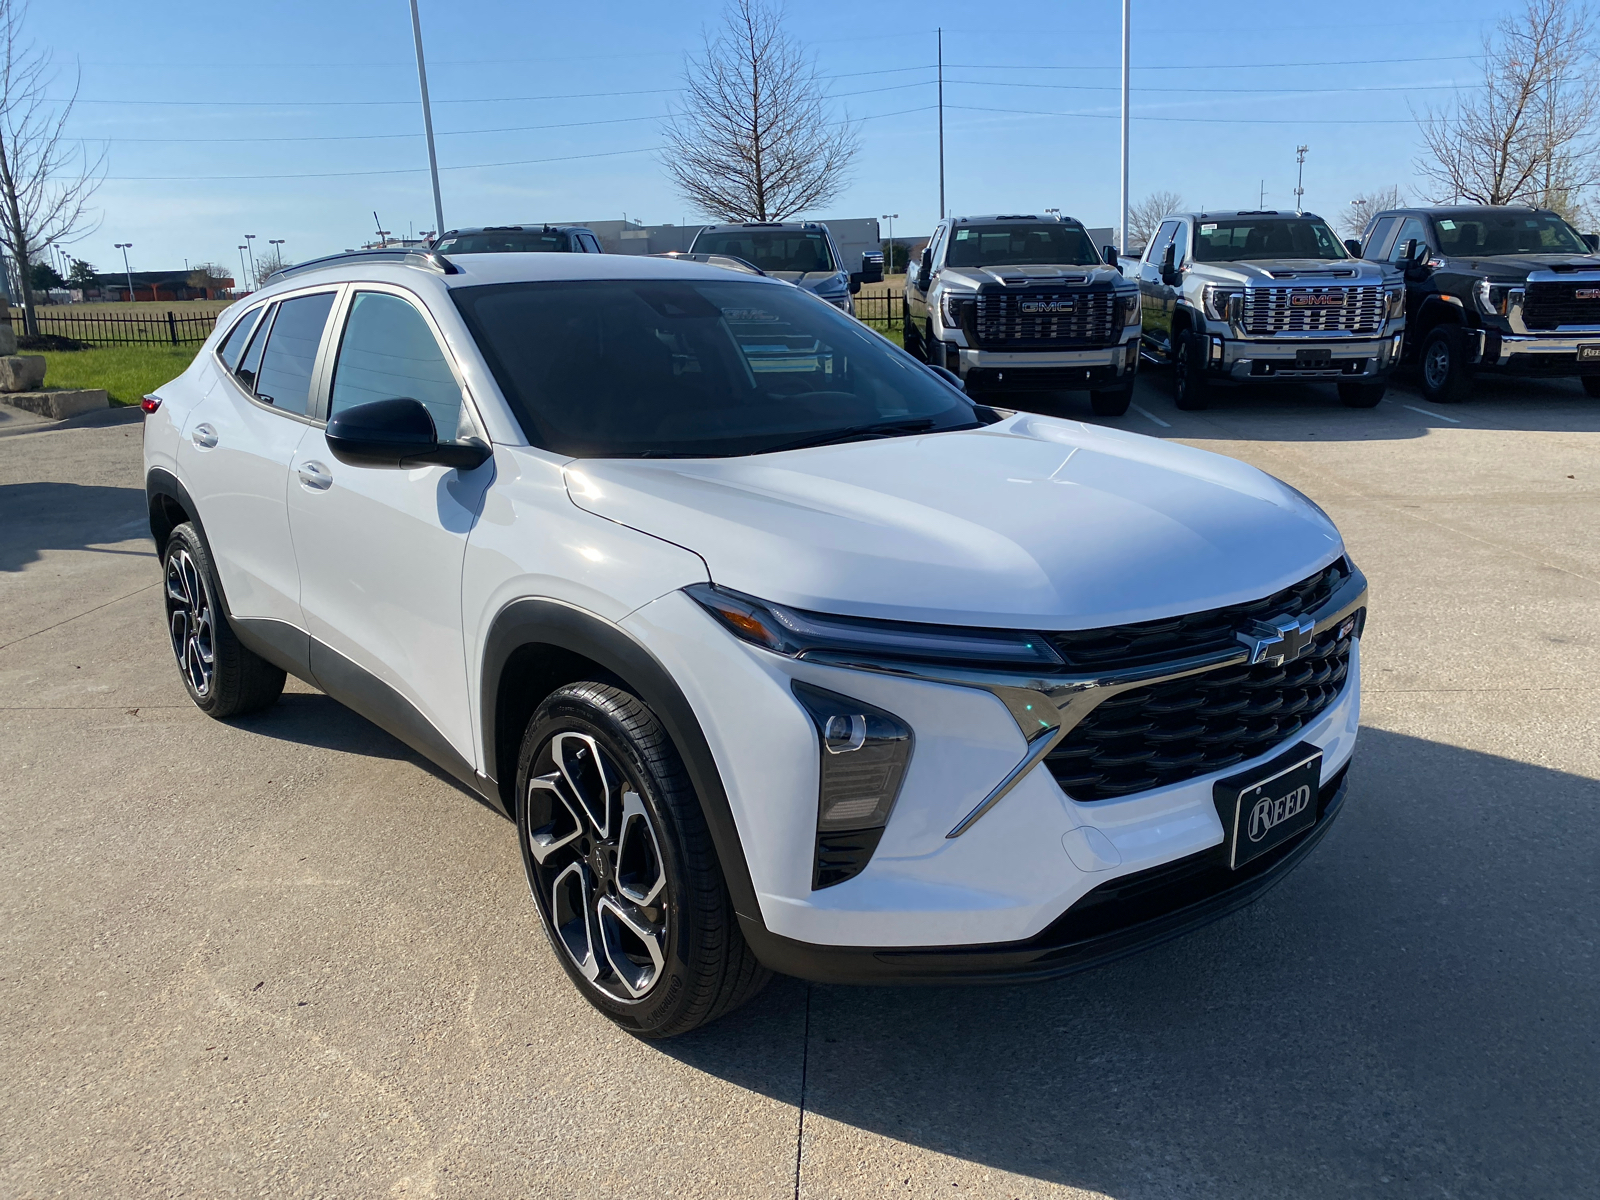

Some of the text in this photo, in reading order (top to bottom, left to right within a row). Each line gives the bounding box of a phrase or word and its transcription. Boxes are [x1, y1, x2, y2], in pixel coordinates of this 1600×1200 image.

[1292, 295, 1343, 305] GMC
[1022, 301, 1074, 312] GMC
[1583, 348, 1600, 357] REE
[1248, 785, 1310, 842] REED
[651, 974, 682, 1022] Continental
